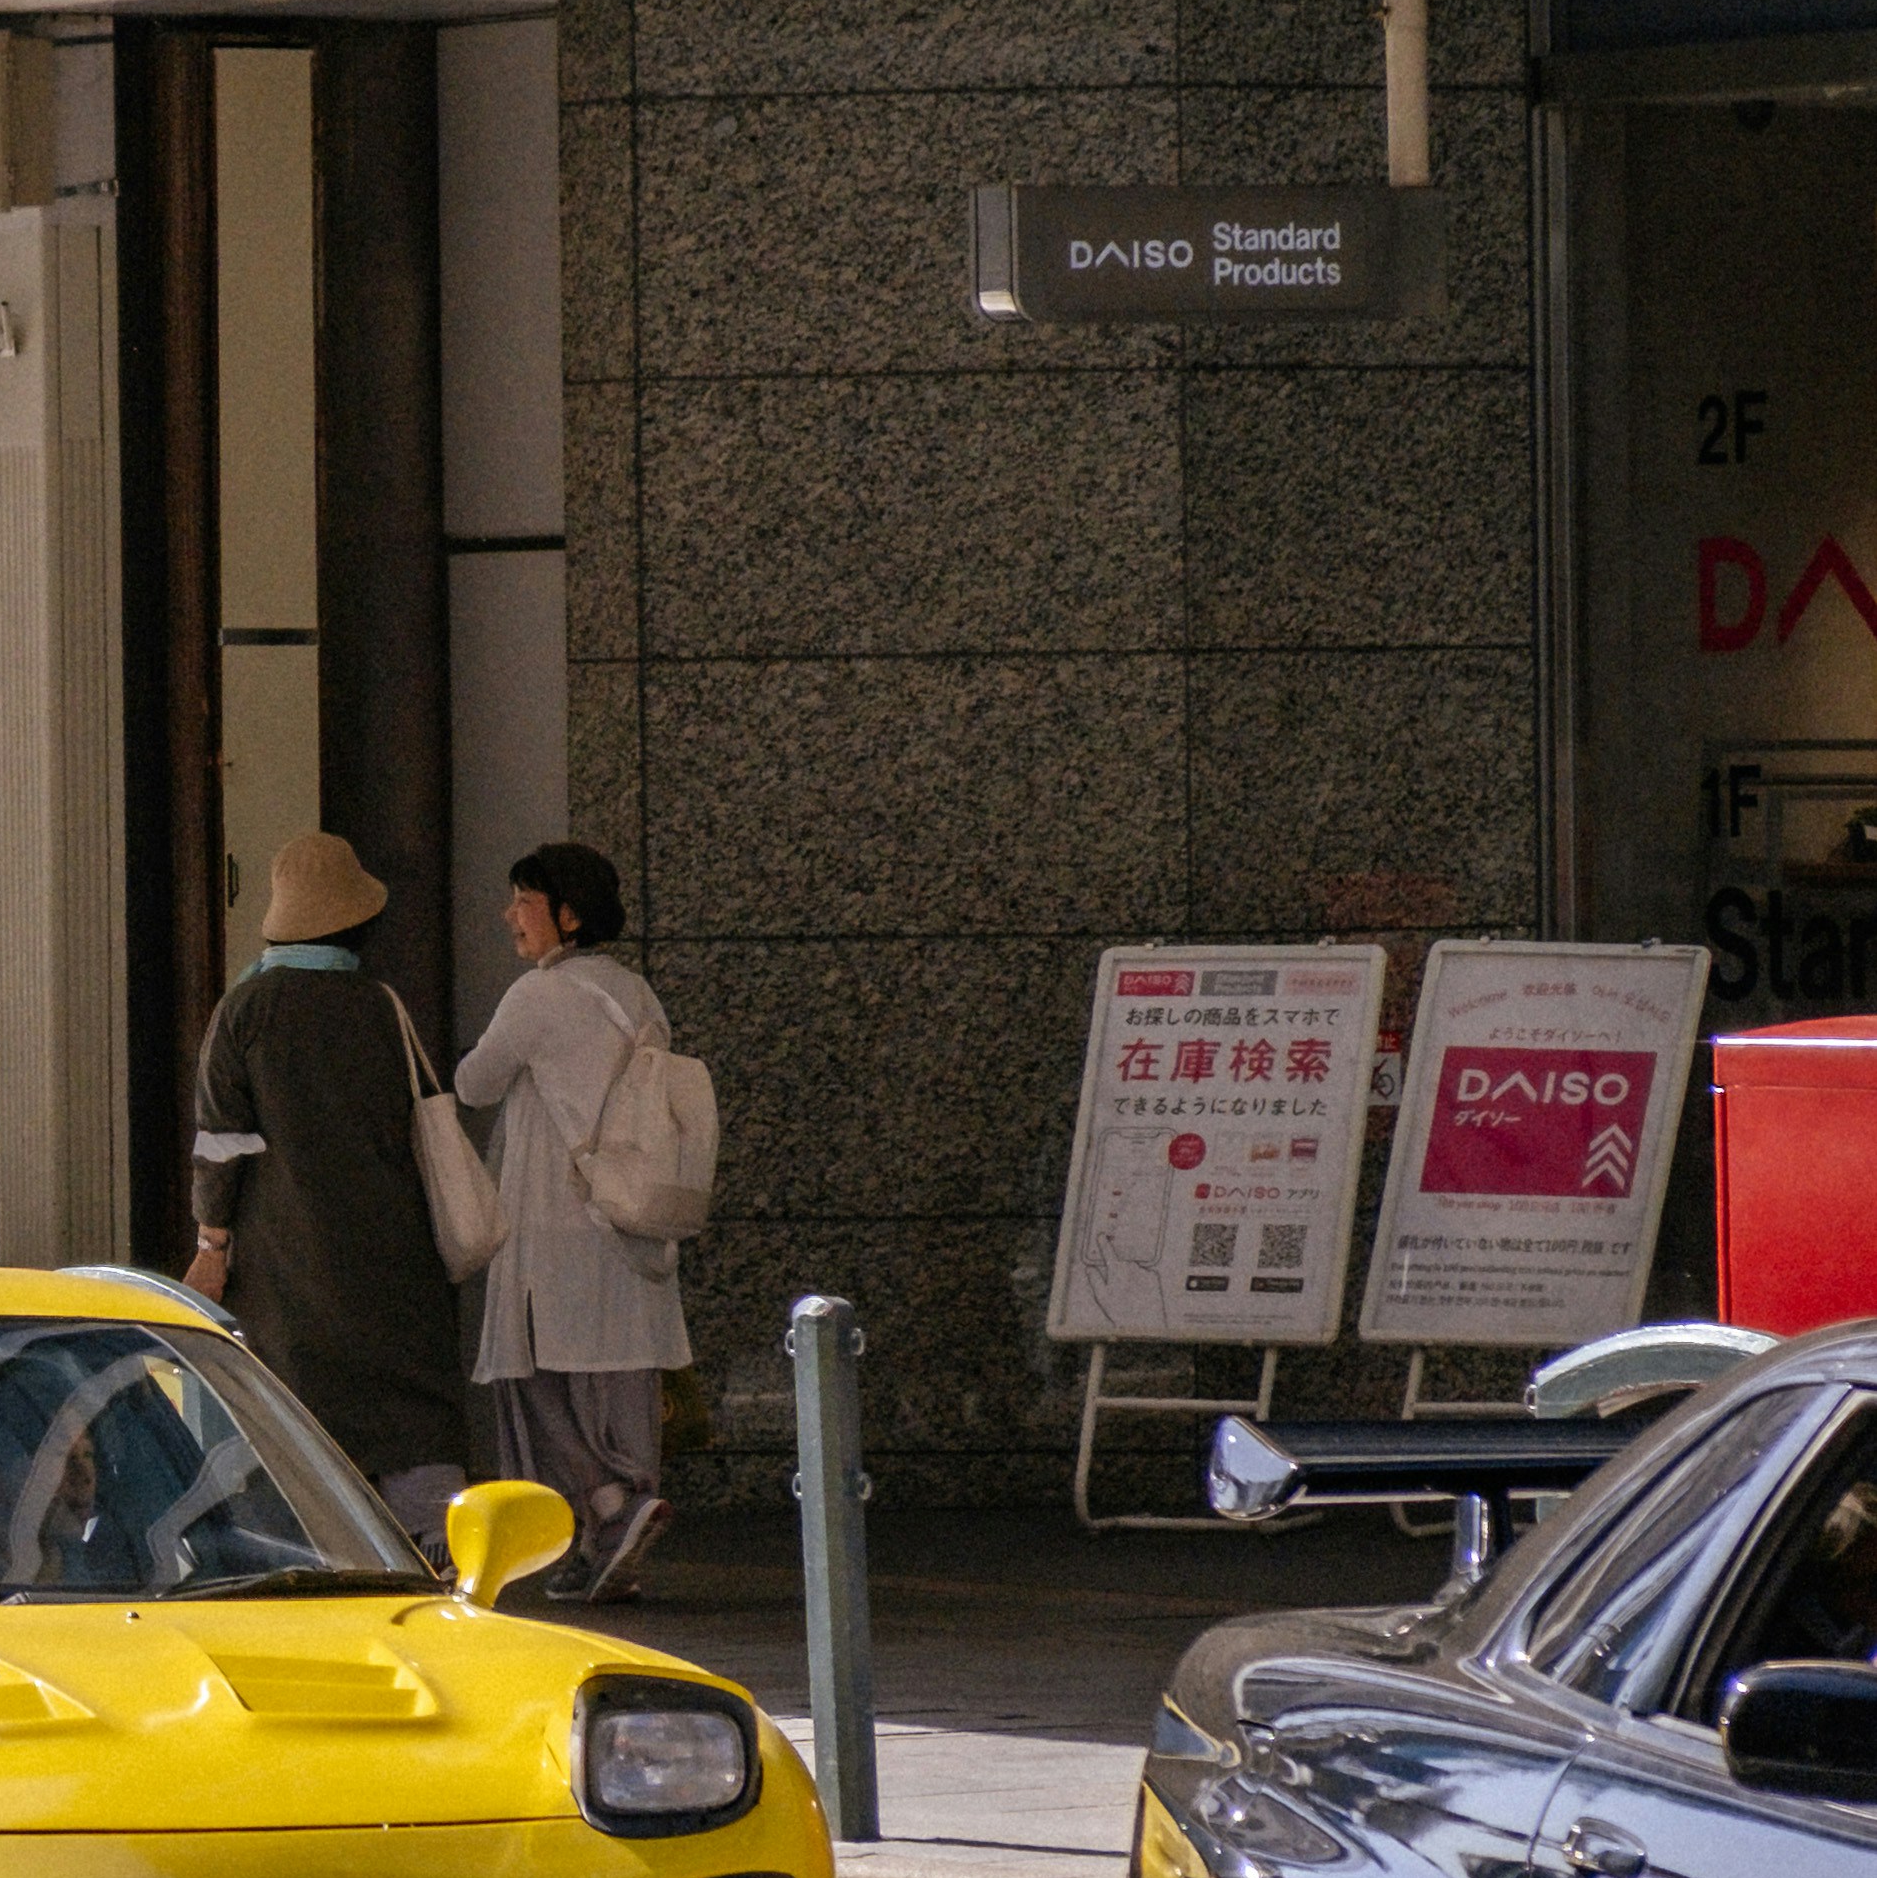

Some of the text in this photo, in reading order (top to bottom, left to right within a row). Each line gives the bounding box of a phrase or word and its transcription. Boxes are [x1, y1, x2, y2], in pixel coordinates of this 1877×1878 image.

[1213, 221, 1342, 251] Standard
[1070, 240, 1194, 269] DAISO
[1214, 257, 1342, 286] Products
[1696, 389, 1768, 465] 2F
[1700, 764, 1762, 839] 1F
[1125, 1007, 1340, 1026] お探しの商品をスマホで
[1117, 1037, 1332, 1084] 在庫検索
[1456, 1068, 1629, 1106] DAISO
[1114, 1096, 1327, 1117] できるようになりました
[1453, 1109, 1522, 1127] ダイソー
[1214, 1186, 1281, 1200] DAISO
